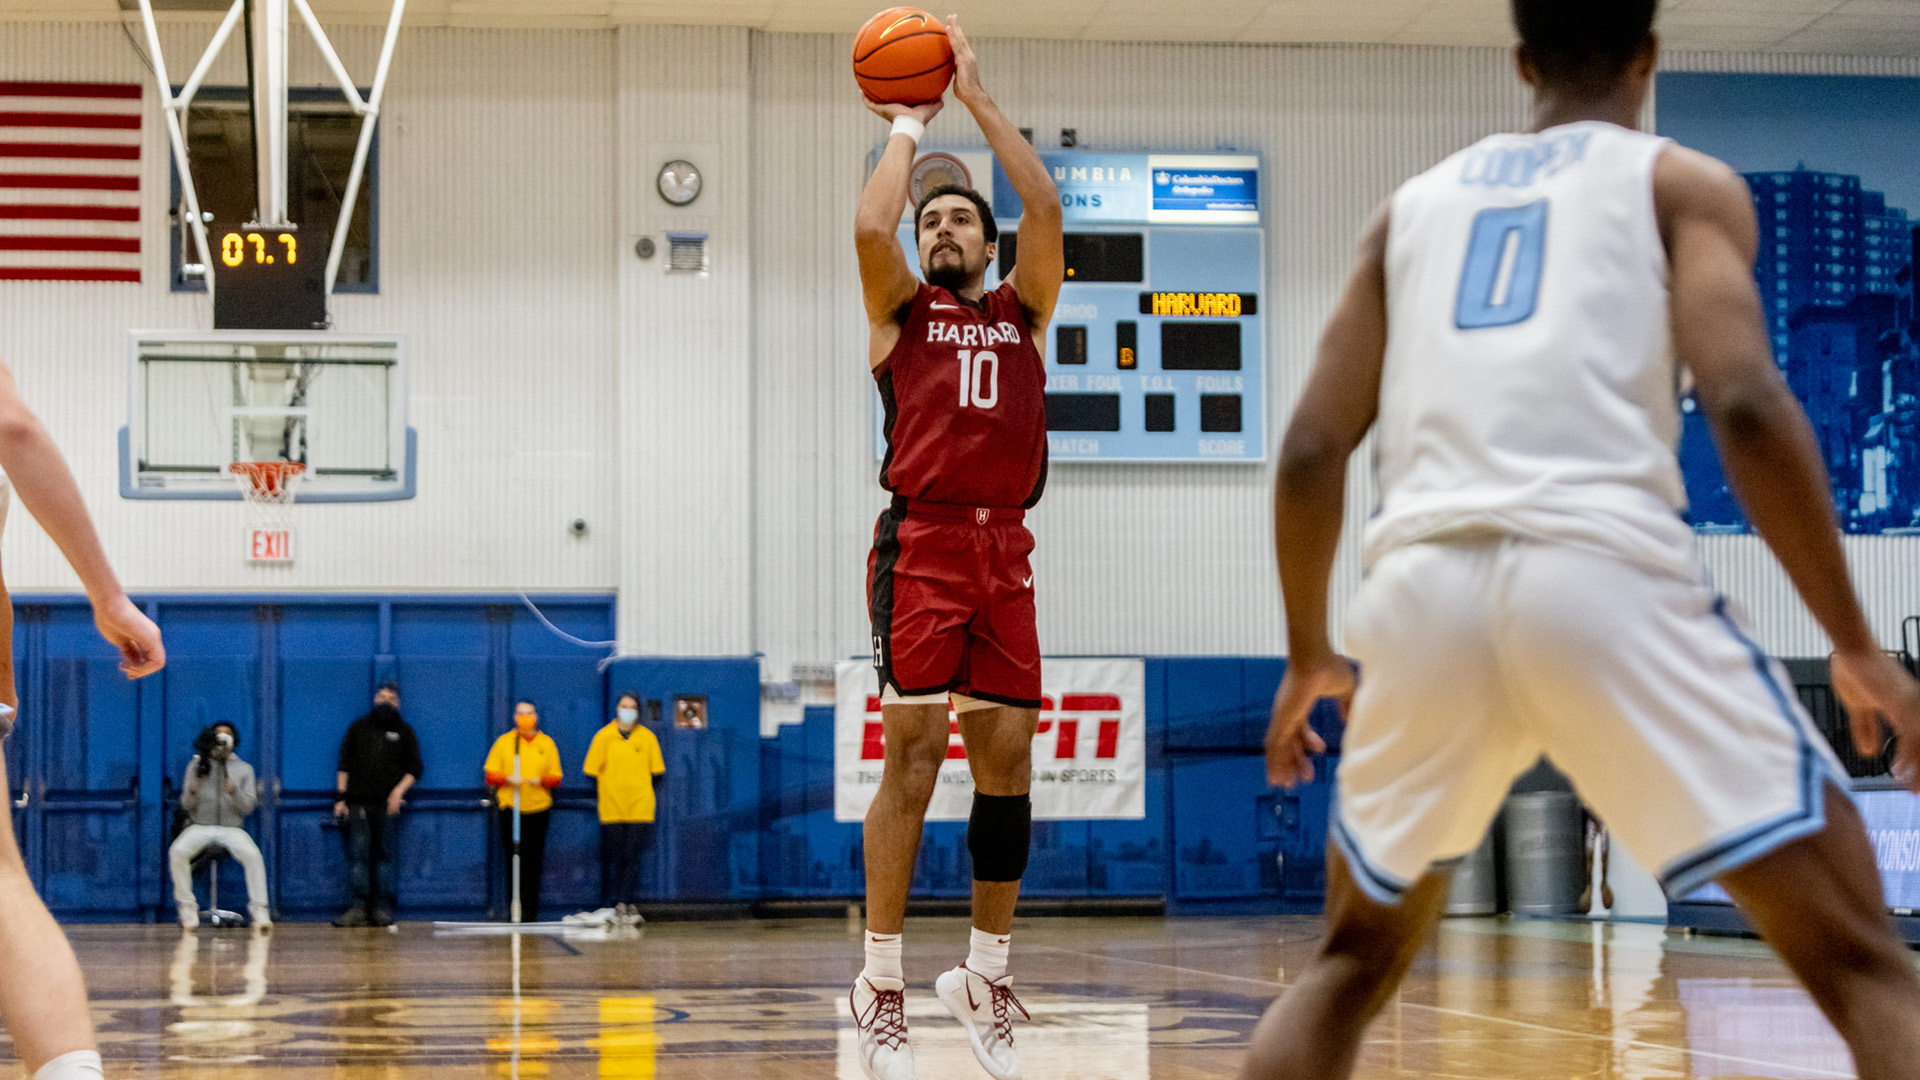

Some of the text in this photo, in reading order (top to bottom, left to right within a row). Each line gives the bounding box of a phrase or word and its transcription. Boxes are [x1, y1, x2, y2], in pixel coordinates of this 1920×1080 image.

[1054, 166, 1132, 181] UMBIA
[1062, 193, 1102, 207] ONS
[222, 232, 297, 267] 07.7
[1455, 197, 1551, 330] 0
[1055, 303, 1098, 319] ERIOD
[1152, 293, 1242, 317] HARVARD
[957, 349, 999, 409] 10
[1047, 375, 1079, 391] YER
[1196, 375, 1244, 391] FOULS
[1198, 440, 1245, 455] SCORE
[252, 530, 290, 558] EXIT
[1060, 768, 1117, 784] SPORTS
